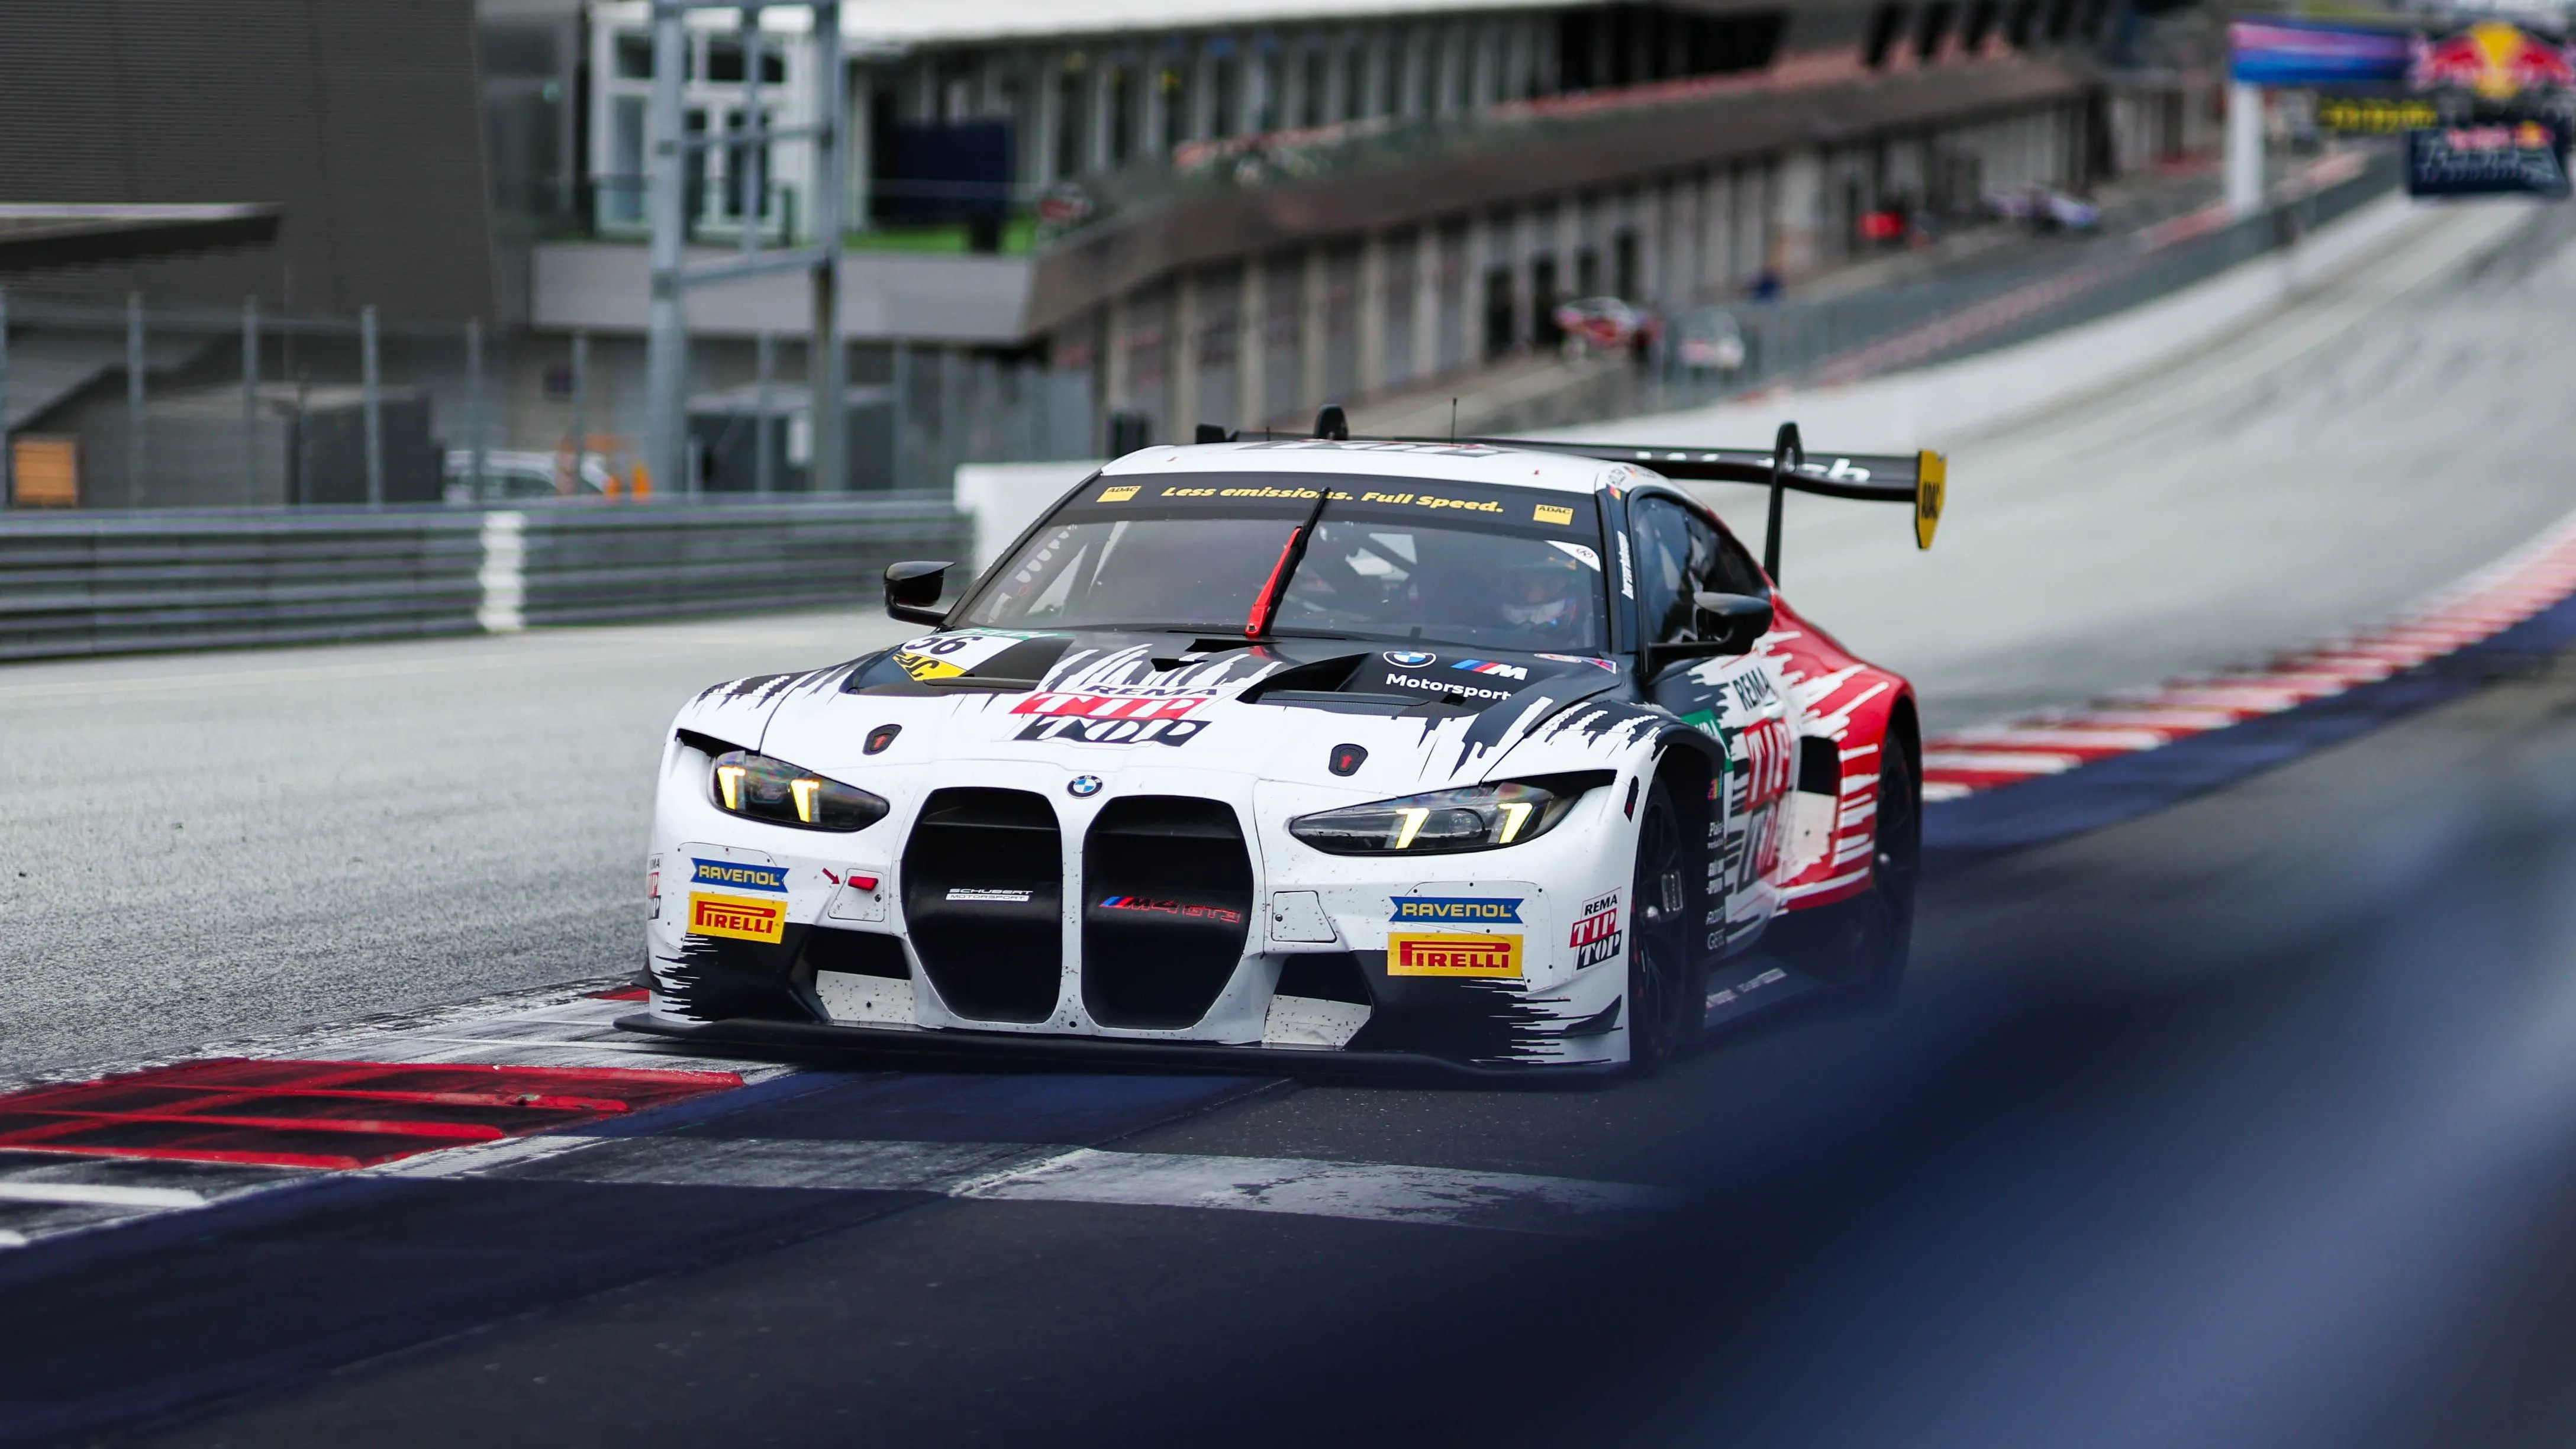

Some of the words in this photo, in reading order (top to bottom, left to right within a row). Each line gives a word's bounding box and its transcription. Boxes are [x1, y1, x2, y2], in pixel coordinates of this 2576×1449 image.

[1161, 486, 1217, 496] Less
[1361, 491, 1412, 504] Full
[1416, 495, 1504, 514] Speed.
[1537, 505, 1571, 515] ADAC
[1083, 685, 1218, 696] REMA
[1386, 673, 1512, 701] Motorsport
[1733, 666, 1769, 711] REMA
[1019, 693, 1205, 718] TIP
[1025, 715, 1204, 745] TOP
[698, 864, 780, 887] RAVENOL
[695, 901, 776, 934] PIRELLI
[1182, 904, 1242, 924] GT3
[1402, 903, 1512, 918] RAVENOL
[1584, 894, 1618, 916] REMA
[1572, 911, 1616, 947] TIP
[1400, 941, 1511, 968] PIRELLI
[1580, 933, 1621, 967] TOP
